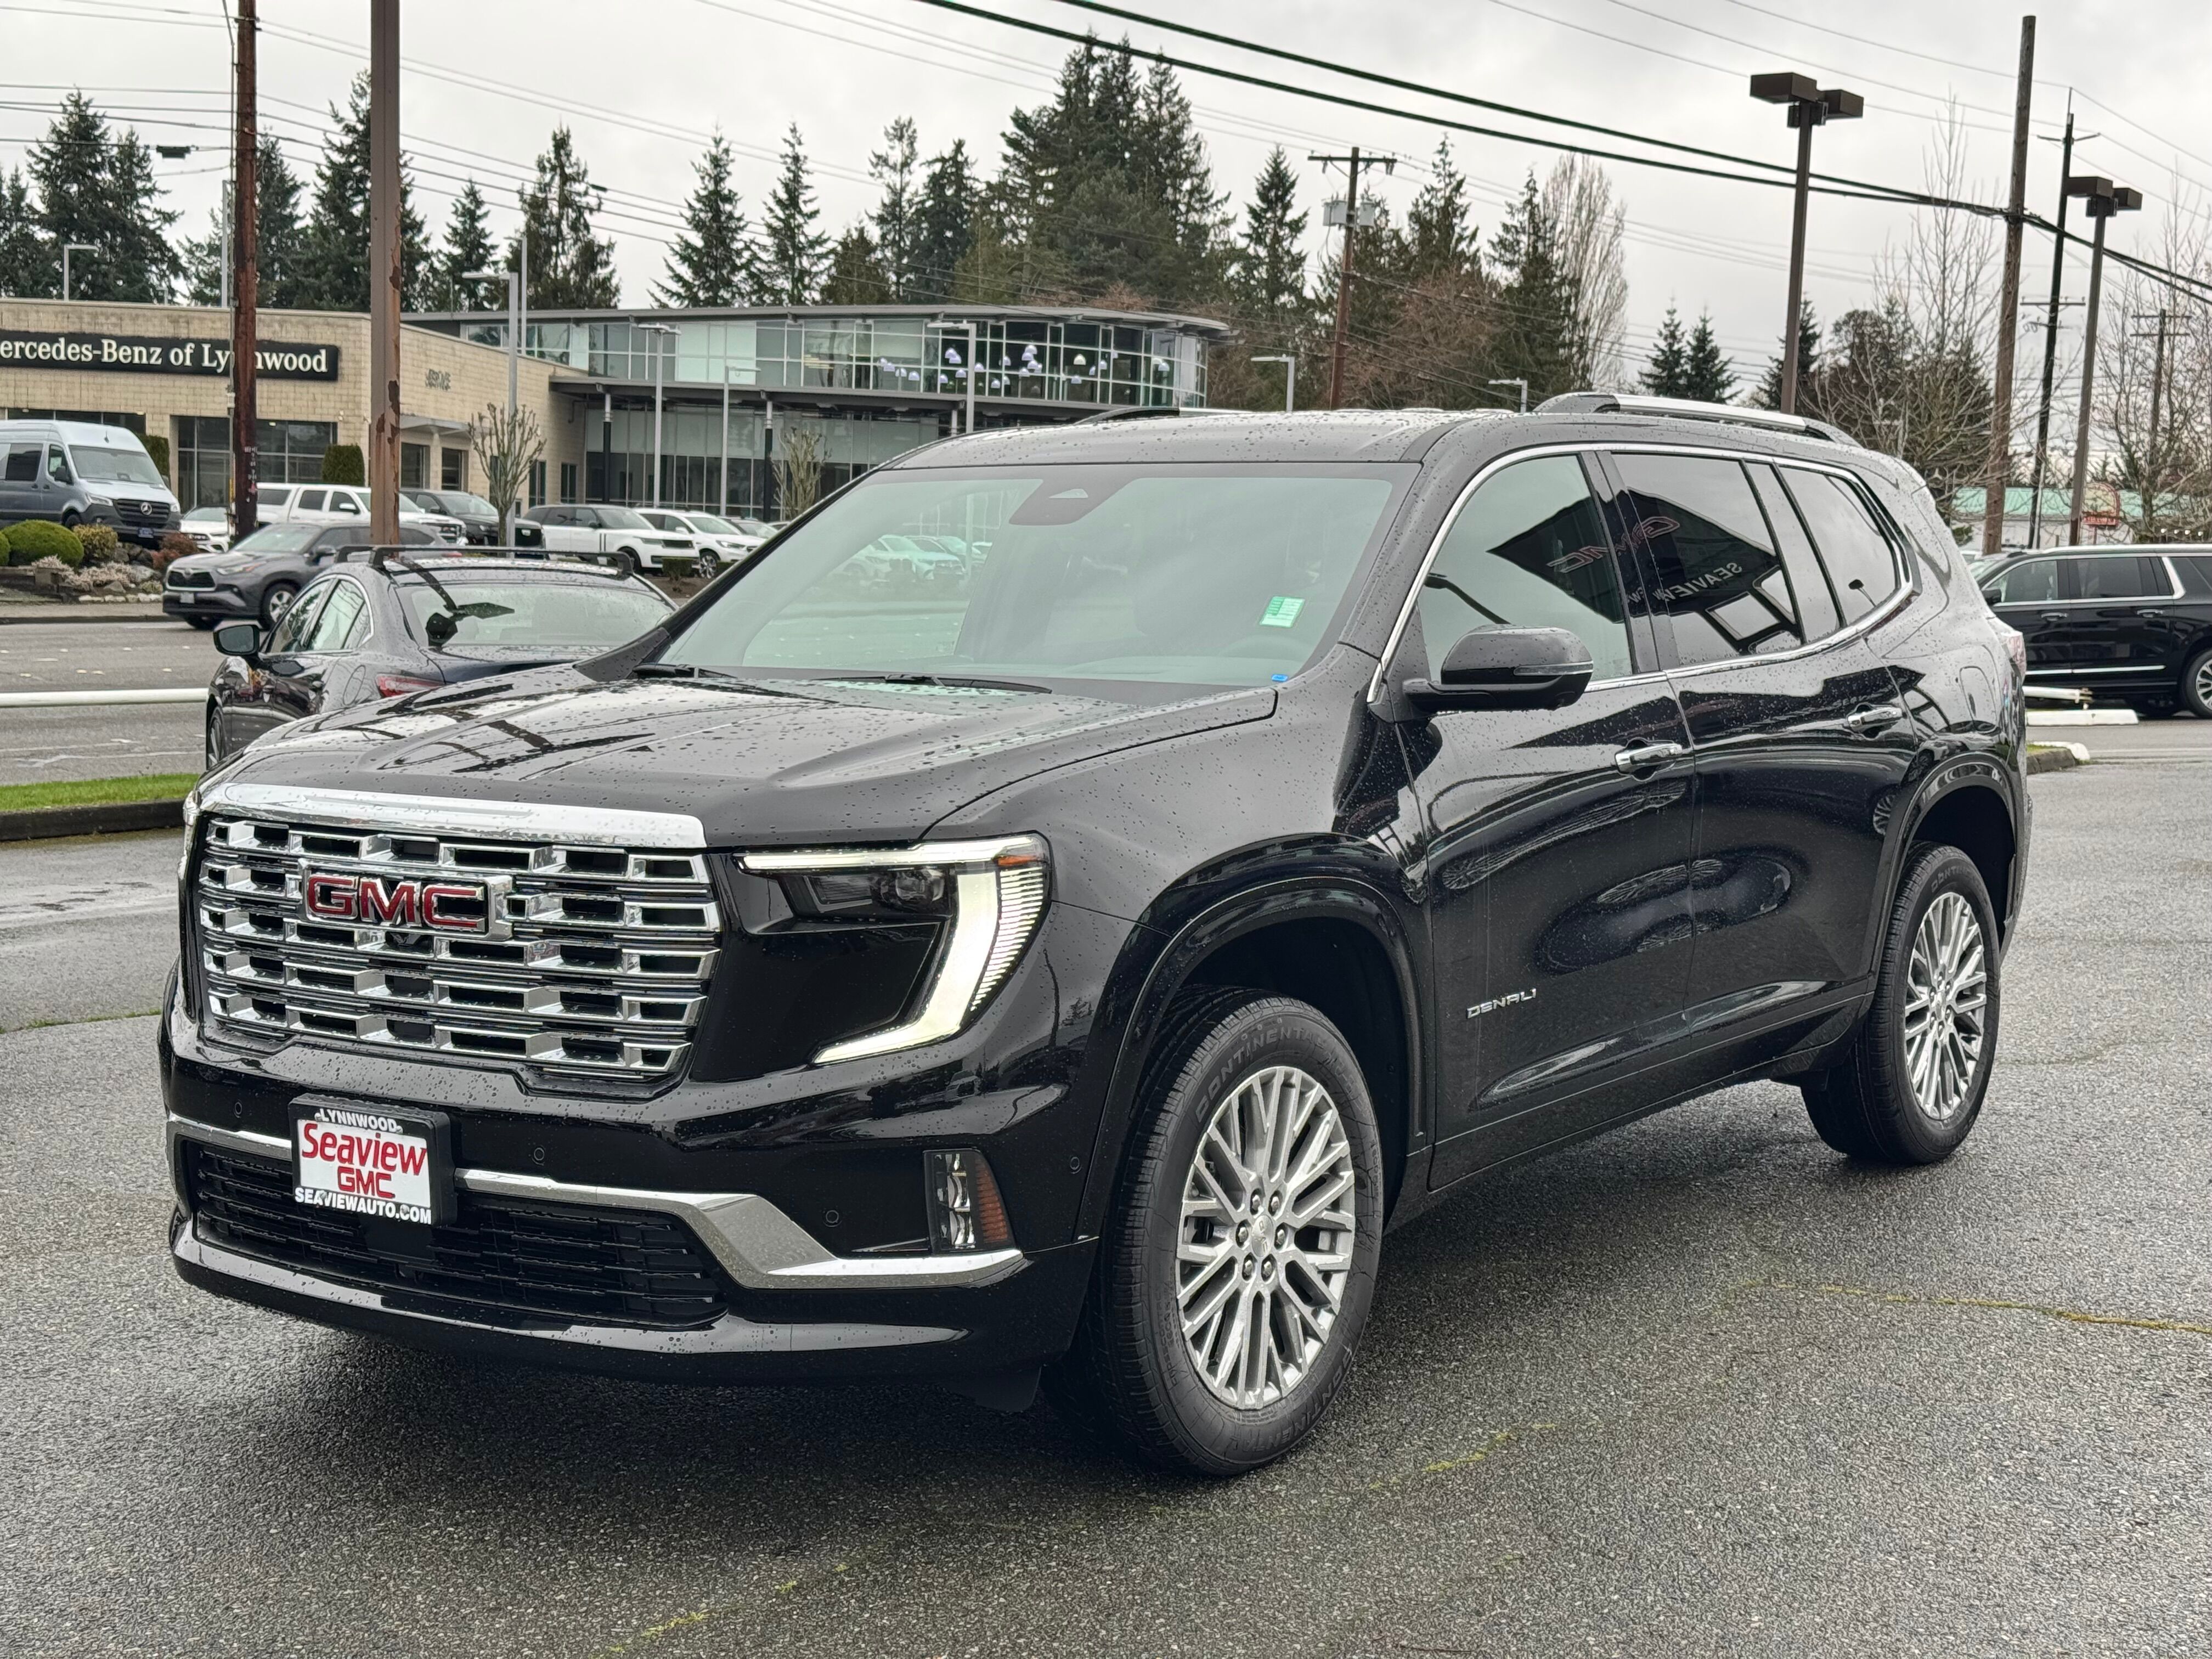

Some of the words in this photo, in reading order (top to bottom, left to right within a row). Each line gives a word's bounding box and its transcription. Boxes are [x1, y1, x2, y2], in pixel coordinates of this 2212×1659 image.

[0, 337, 163, 365] ercedes-Benz
[169, 342, 195, 367] of
[201, 343, 328, 373] Lynwood
[307, 874, 486, 932] GMC
[1466, 988, 1537, 1019] DENALI
[319, 1108, 398, 1133] LYNNWOOD
[302, 1122, 427, 1176] Seaview
[337, 1165, 396, 1199] GMC
[294, 1187, 432, 1224] SEAVIEWAUTO.COM
